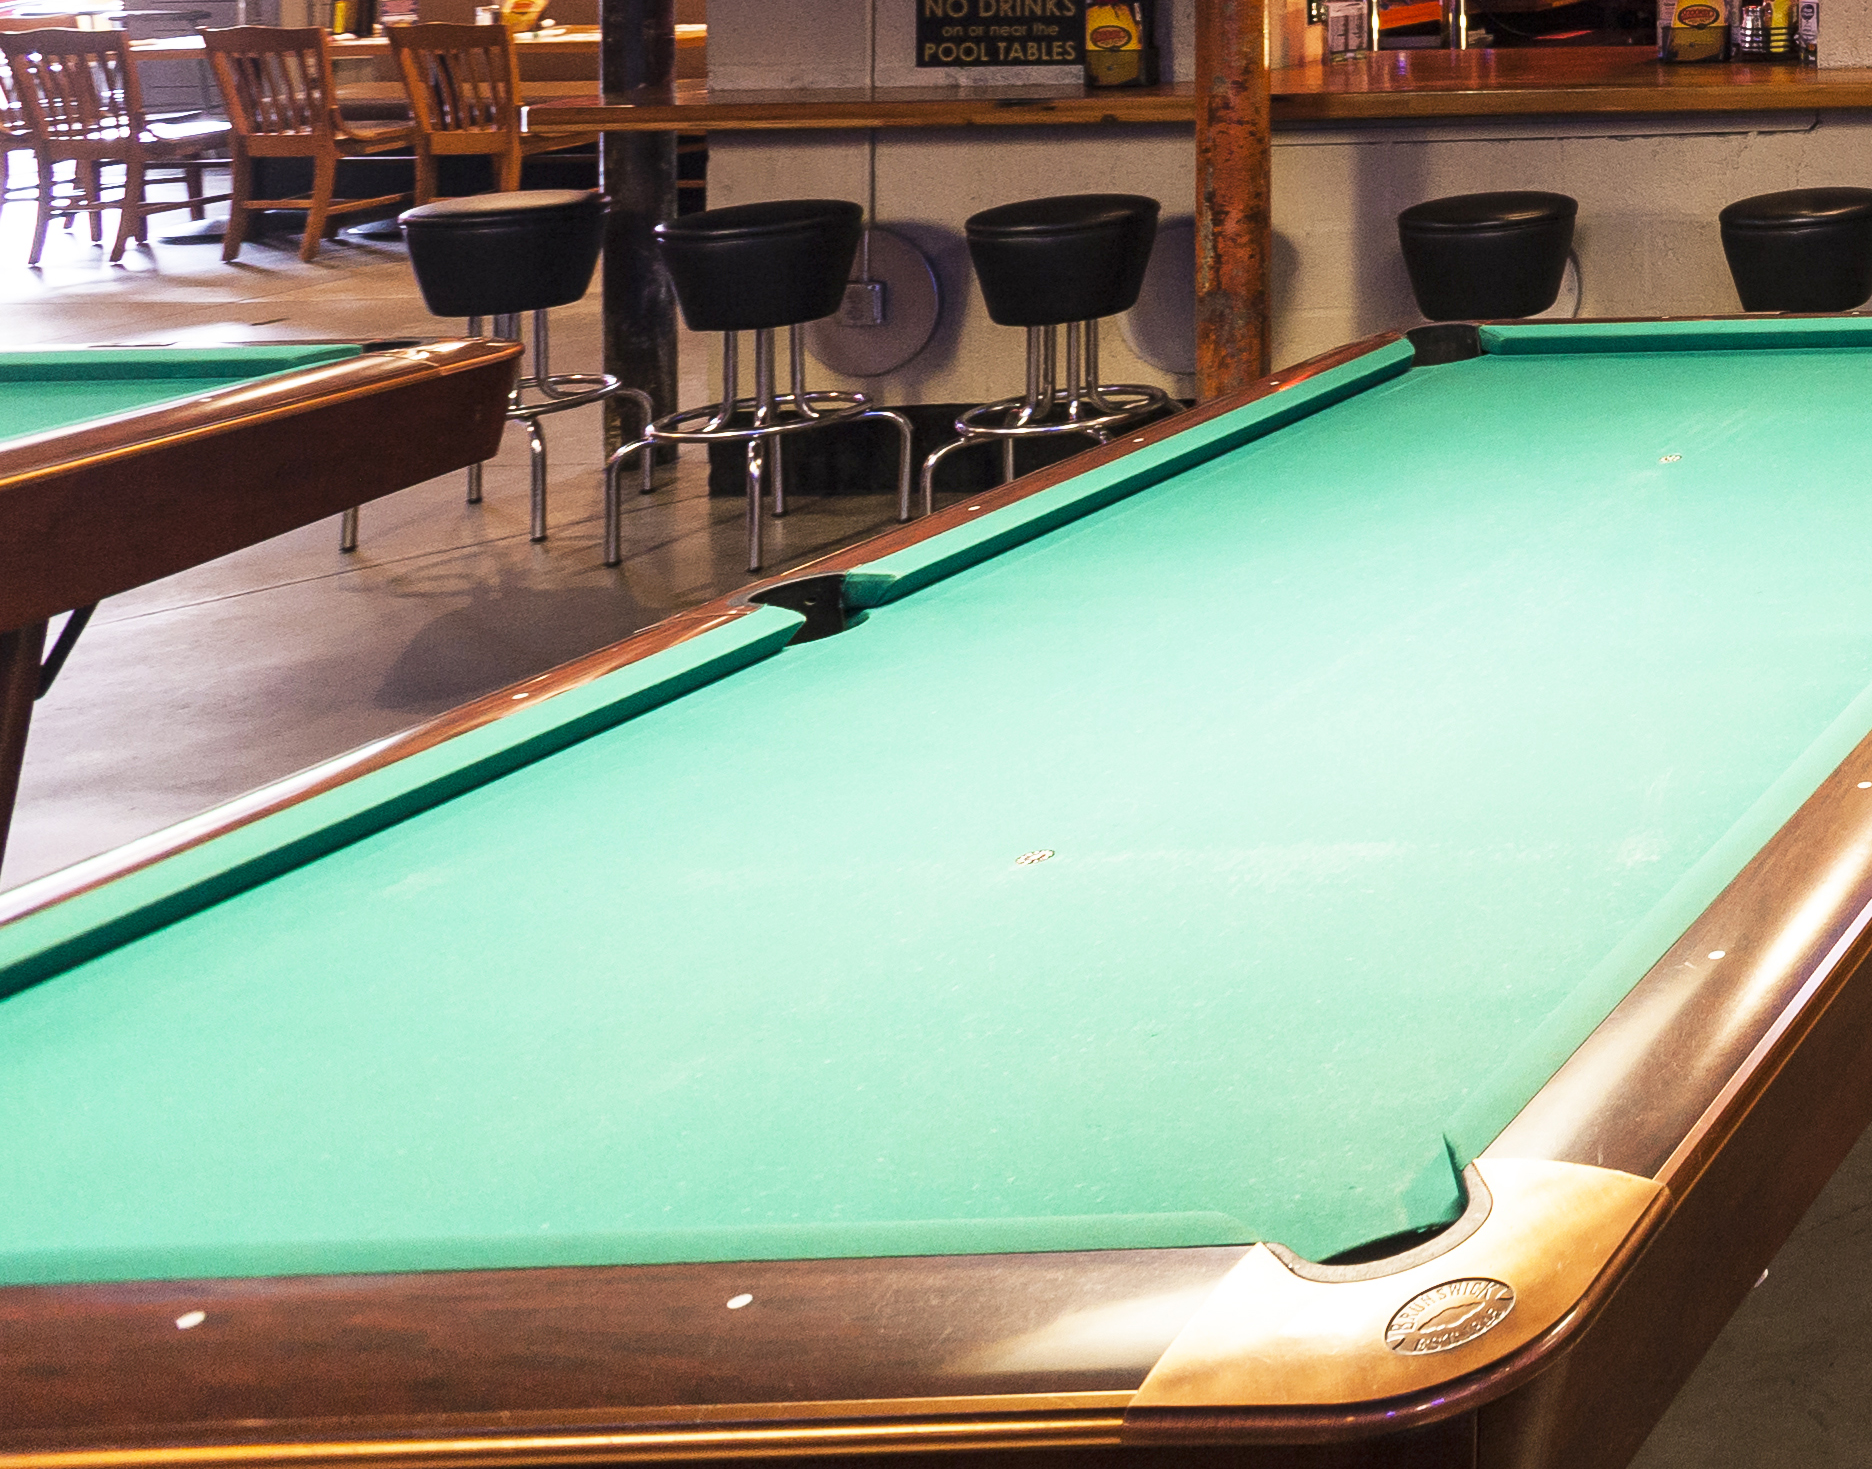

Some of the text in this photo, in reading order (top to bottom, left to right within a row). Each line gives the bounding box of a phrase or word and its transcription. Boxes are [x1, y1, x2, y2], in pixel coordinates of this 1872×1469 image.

[941, 22, 1060, 37] on or near the
[923, 41, 1077, 62] POOL TABLES
[1390, 1280, 1499, 1332] BRUNSWICK
